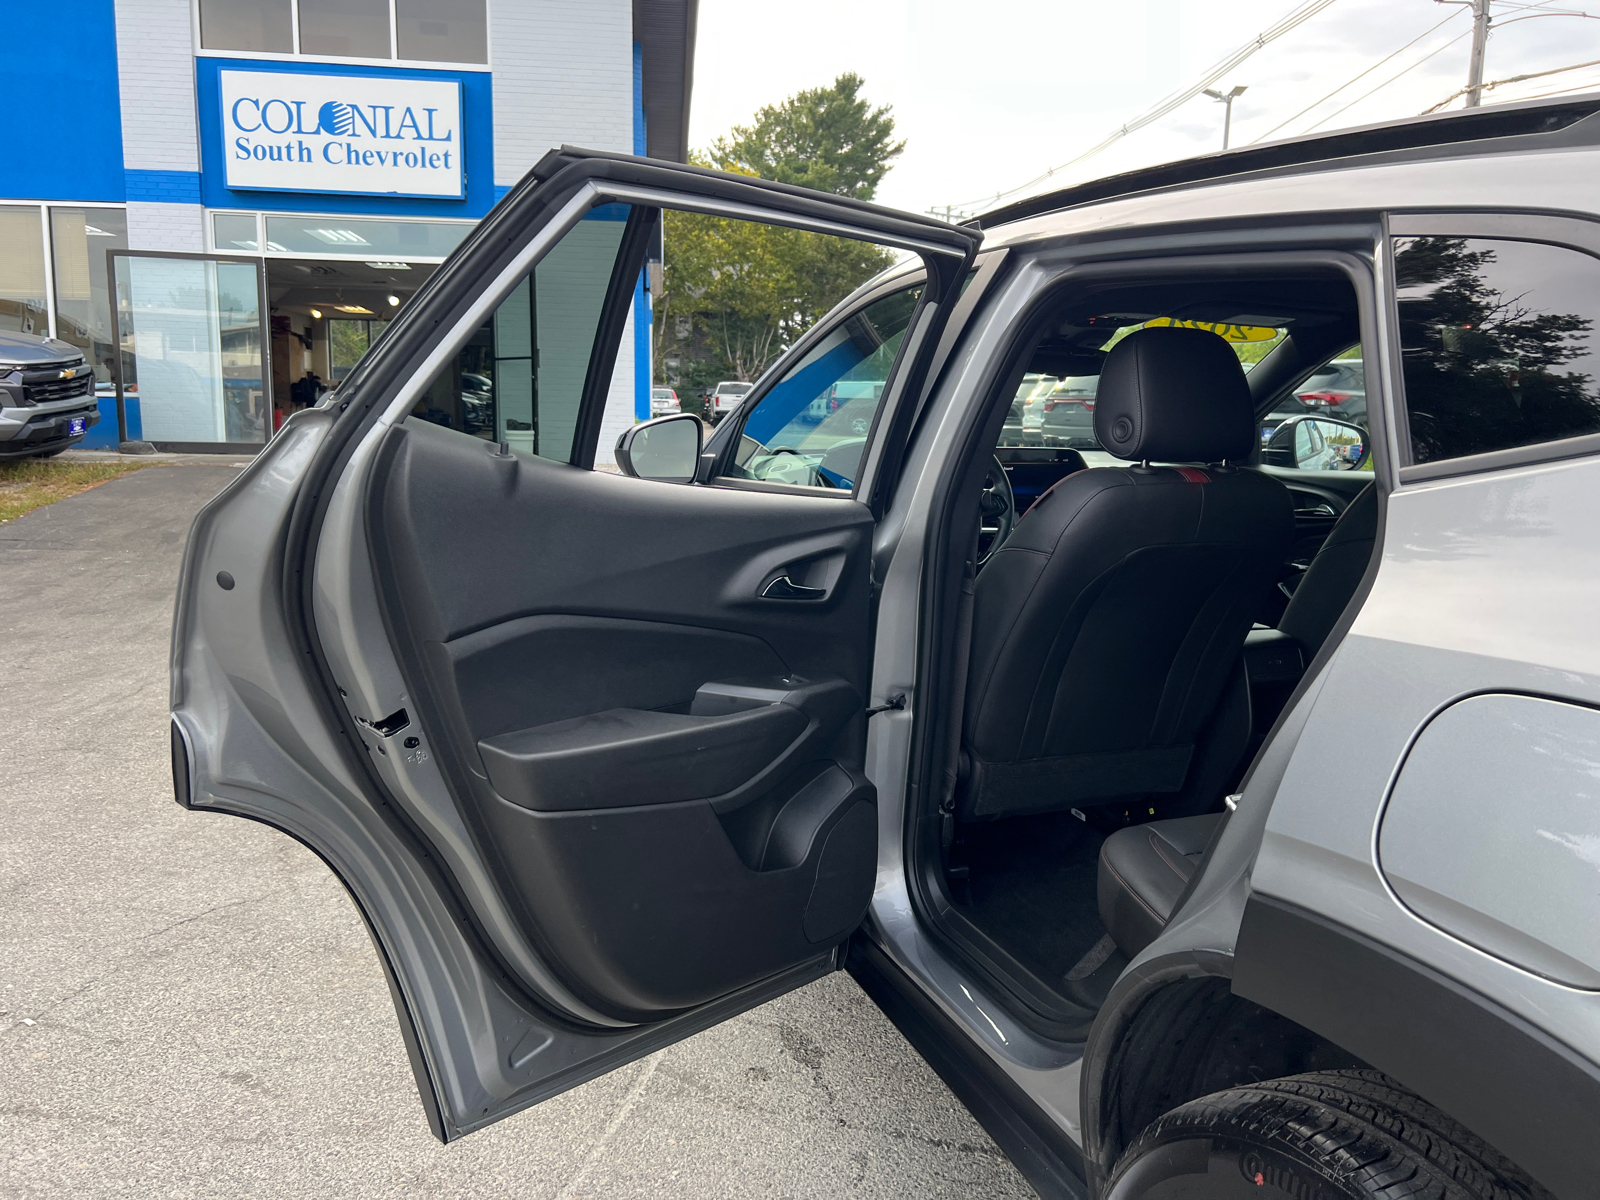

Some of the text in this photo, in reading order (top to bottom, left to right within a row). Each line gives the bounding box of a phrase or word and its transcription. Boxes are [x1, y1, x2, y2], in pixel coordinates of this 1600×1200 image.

[231, 97, 452, 142] COLONIAL
[235, 136, 452, 170] South Chevrolet
